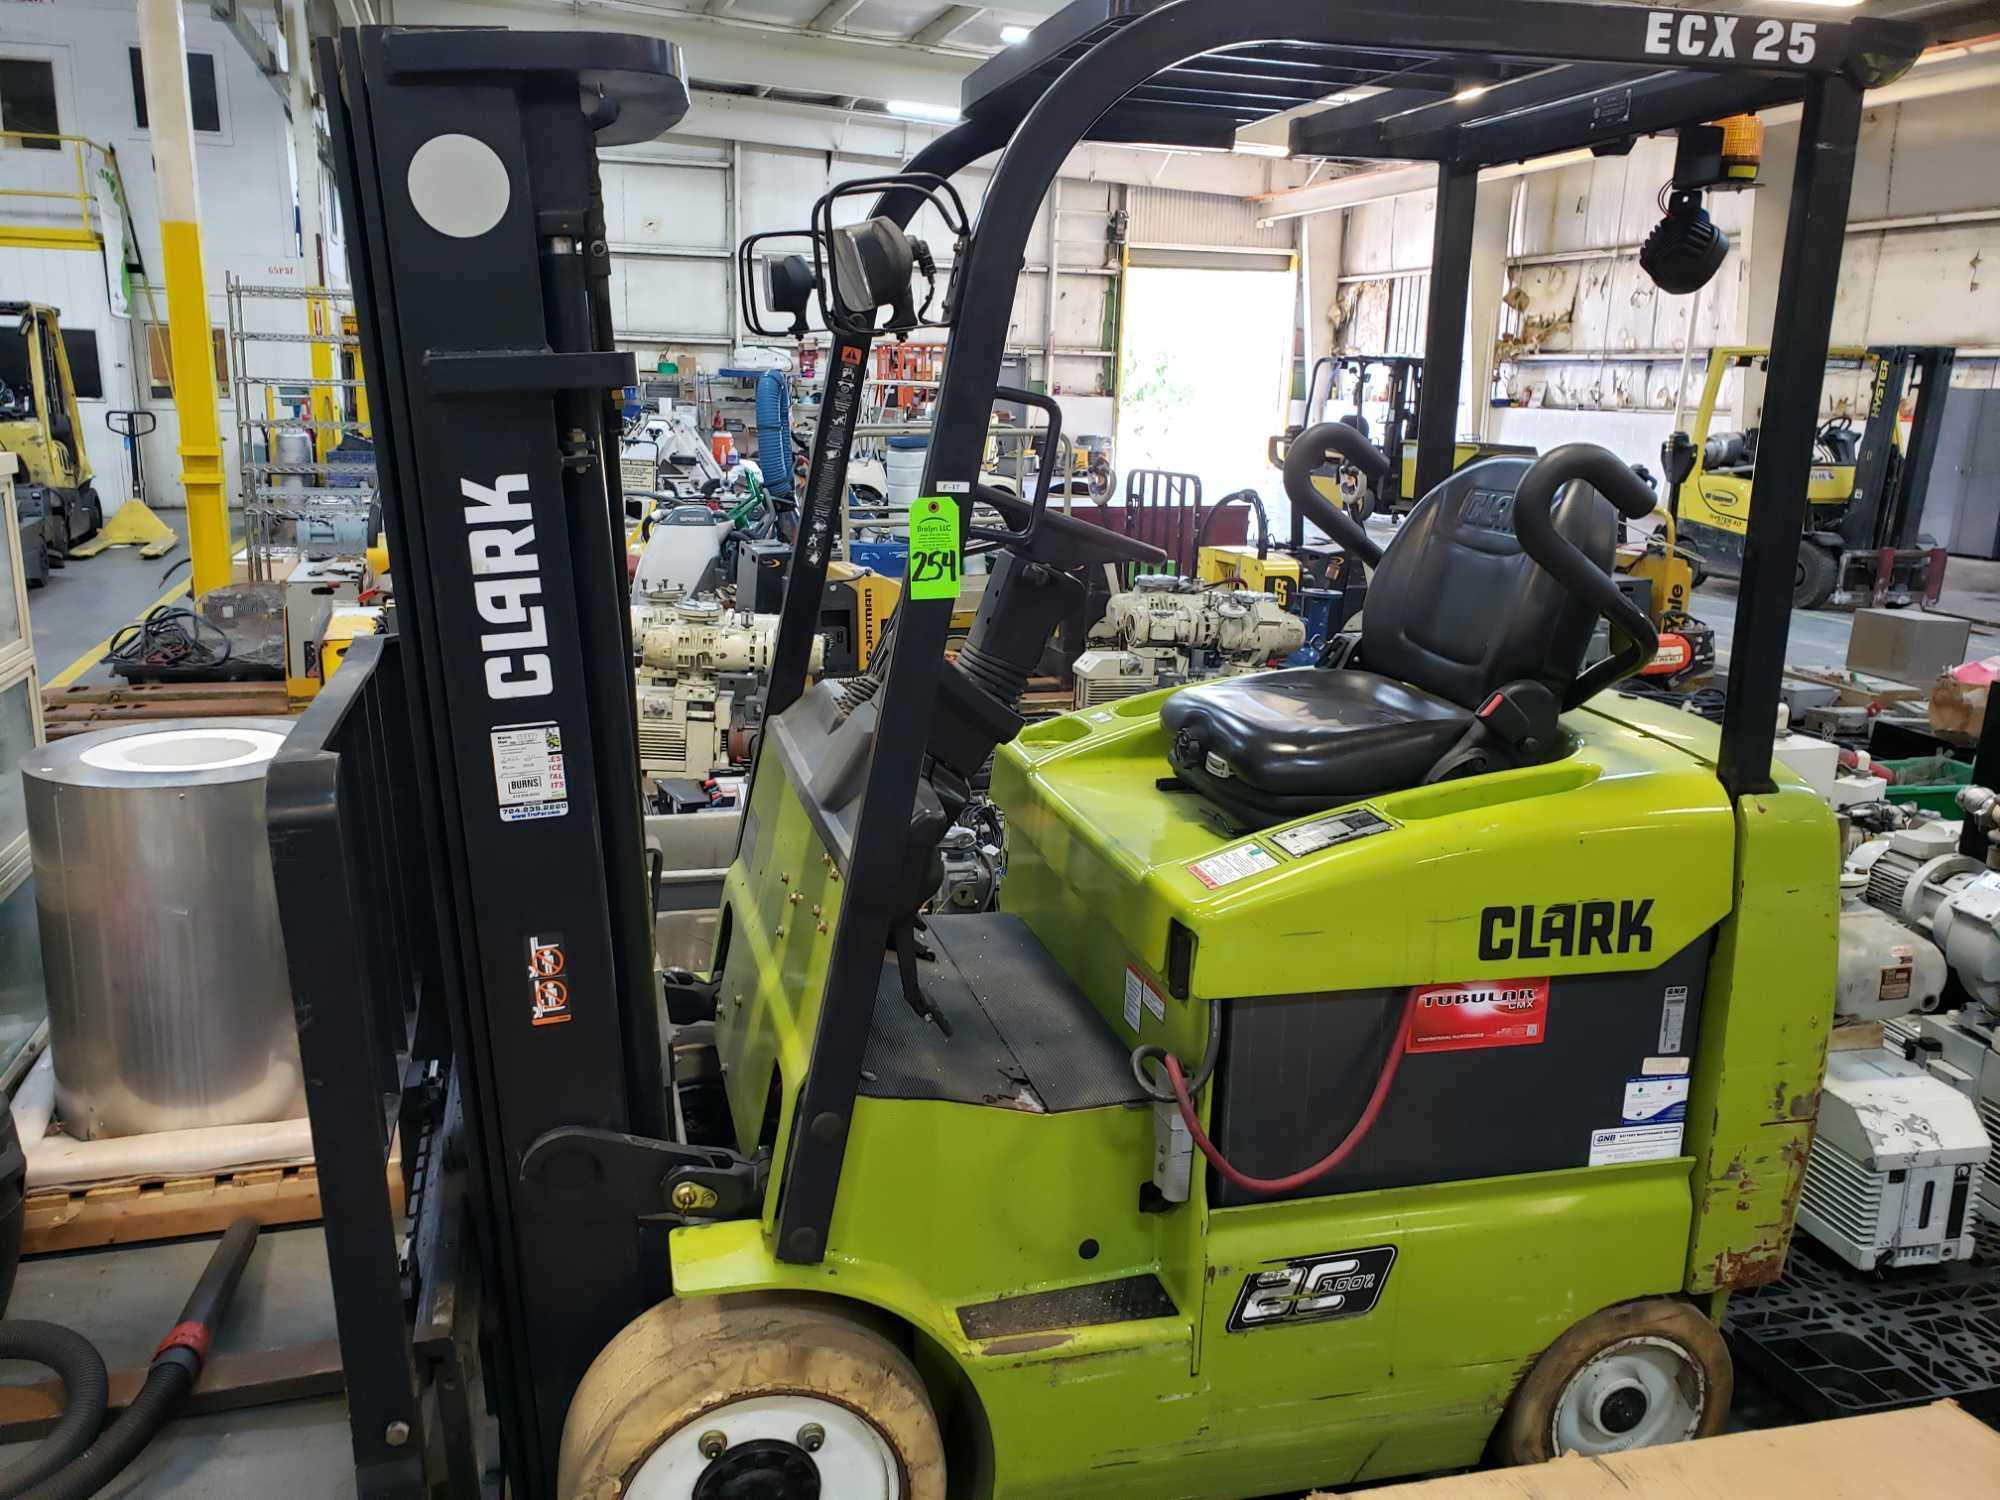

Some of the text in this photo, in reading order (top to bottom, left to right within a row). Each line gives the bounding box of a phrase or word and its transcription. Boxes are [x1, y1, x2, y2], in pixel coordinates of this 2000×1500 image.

[1644, 11, 1817, 64] ECX 25
[1870, 360, 1889, 418] HYSTER
[939, 524, 952, 532] LLC
[911, 549, 957, 582] 254
[460, 473, 554, 700] CLARK
[511, 779, 540, 790] BURNS
[1478, 898, 1655, 961] CLARK
[1423, 989, 1535, 1008] TUBULAR
[1508, 1000, 1534, 1009] CMX
[1596, 1134, 1616, 1143] GNB
